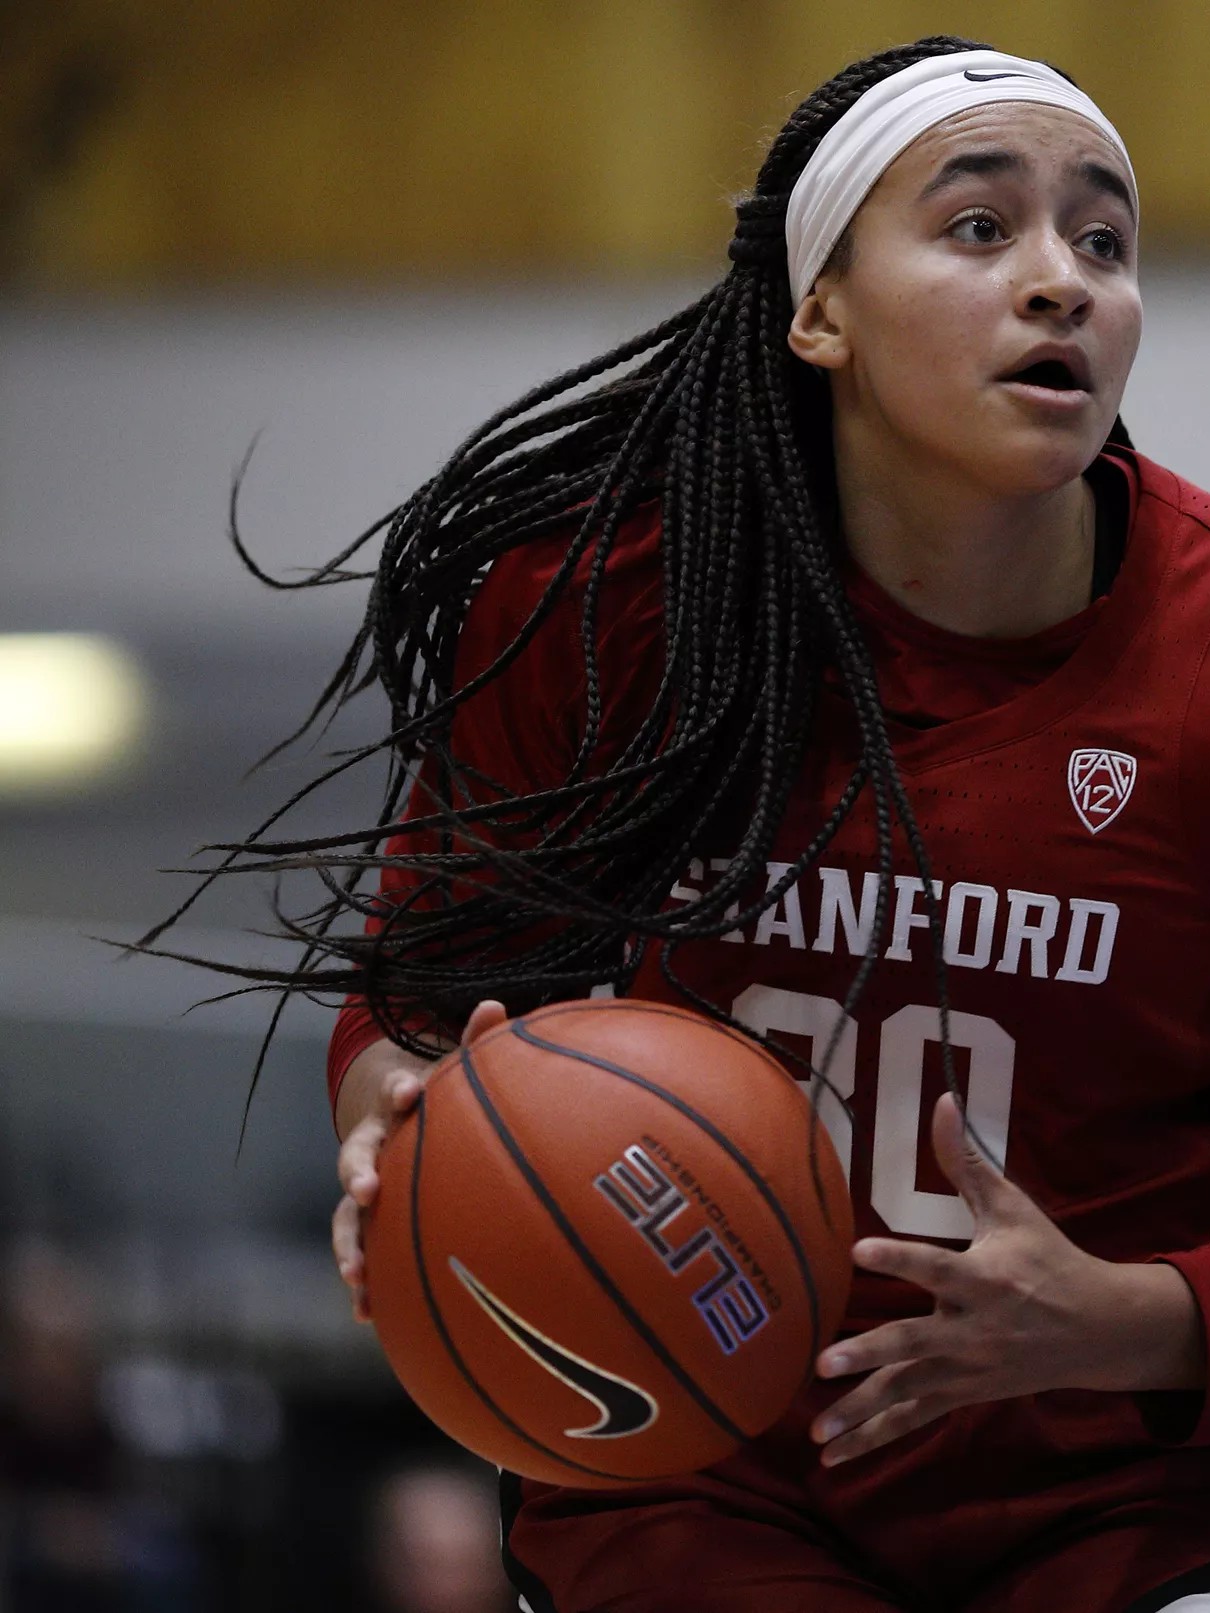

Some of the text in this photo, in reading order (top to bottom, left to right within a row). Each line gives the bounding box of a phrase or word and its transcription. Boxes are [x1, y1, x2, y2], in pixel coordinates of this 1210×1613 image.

[1073, 753, 1132, 800] PAC
[1082, 784, 1115, 814] 12
[592, 1144, 769, 1355] ELITE
